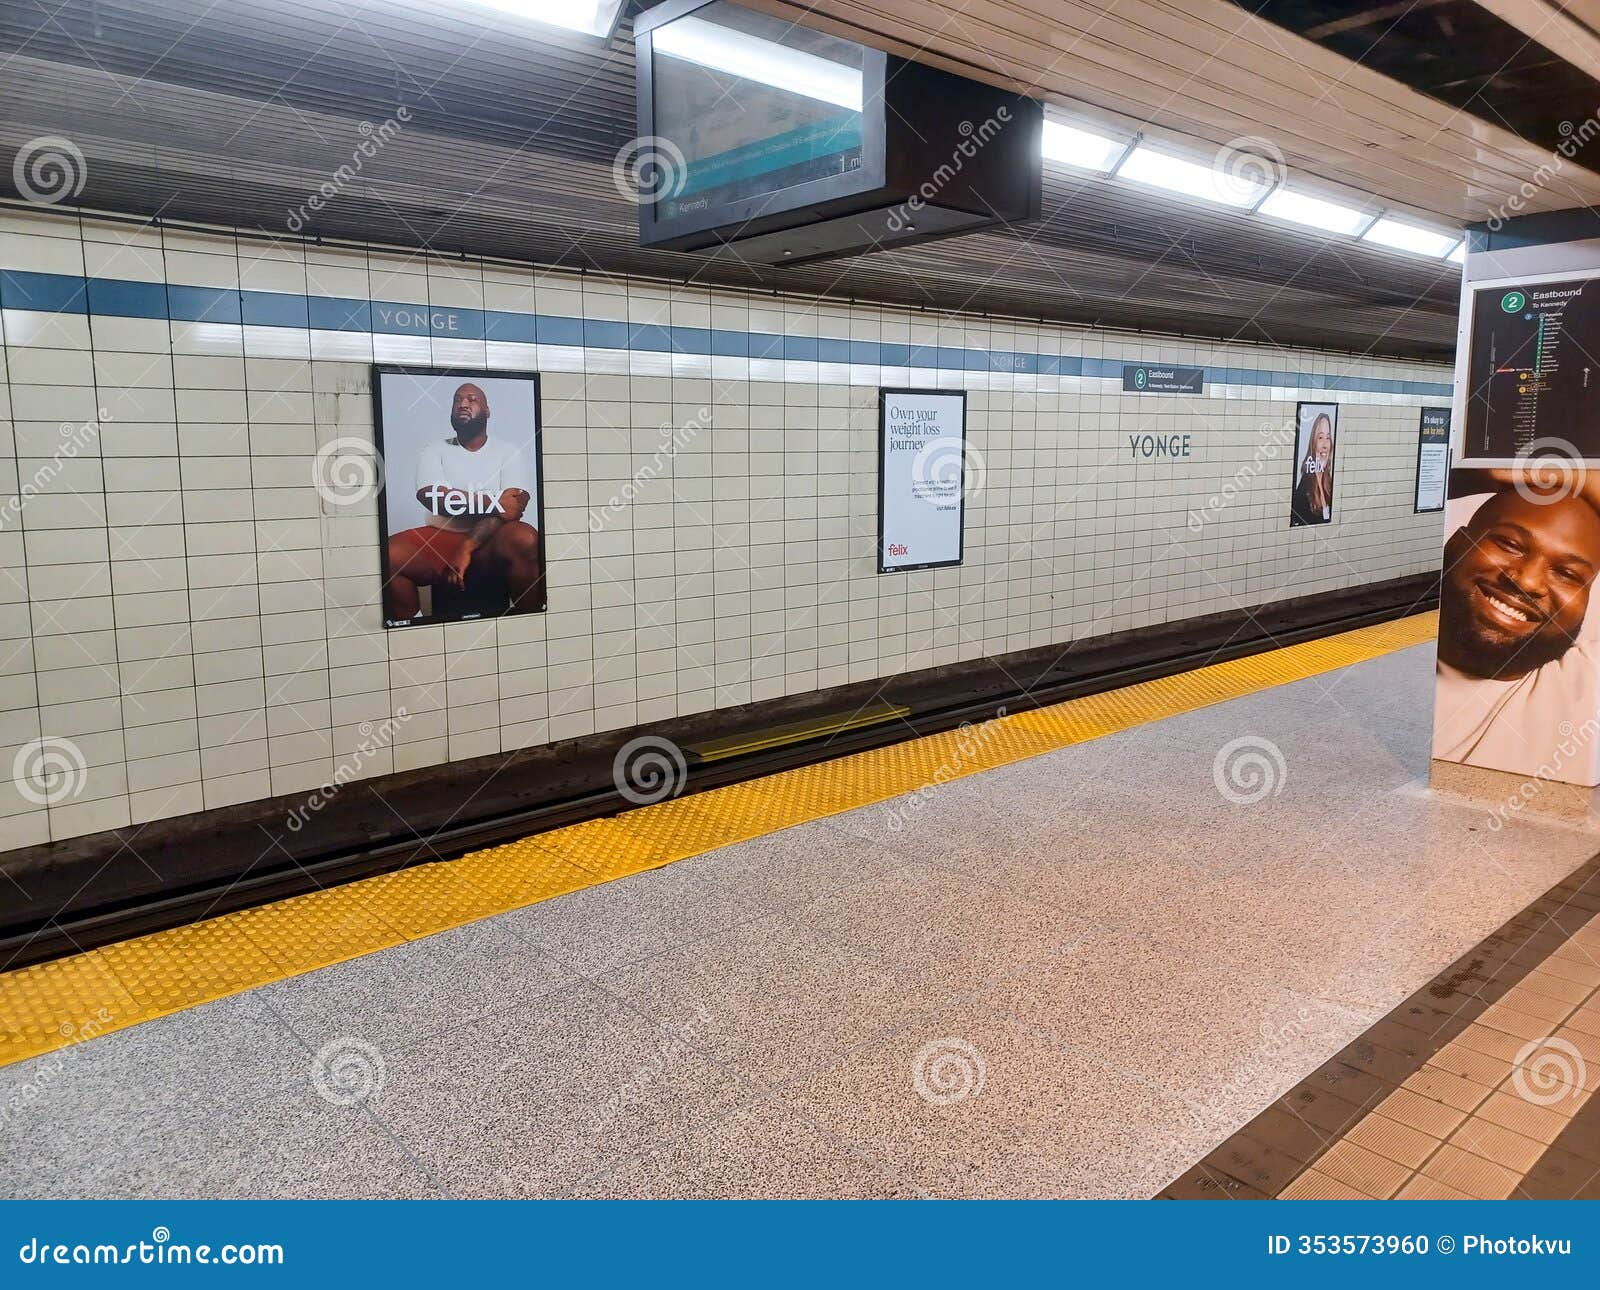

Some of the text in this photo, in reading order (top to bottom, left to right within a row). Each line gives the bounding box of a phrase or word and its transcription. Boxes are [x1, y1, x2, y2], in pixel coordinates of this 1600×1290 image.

[1508, 288, 1582, 308] 2 Eastbound
[380, 310, 458, 330] YONGE
[890, 406, 937, 424] Own your
[890, 421, 940, 438] weight loss
[890, 436, 925, 453] journey
[1129, 435, 1190, 457] YONGE
[1305, 456, 1324, 474] felix
[425, 483, 506, 516] felix
[888, 544, 908, 556] felix
